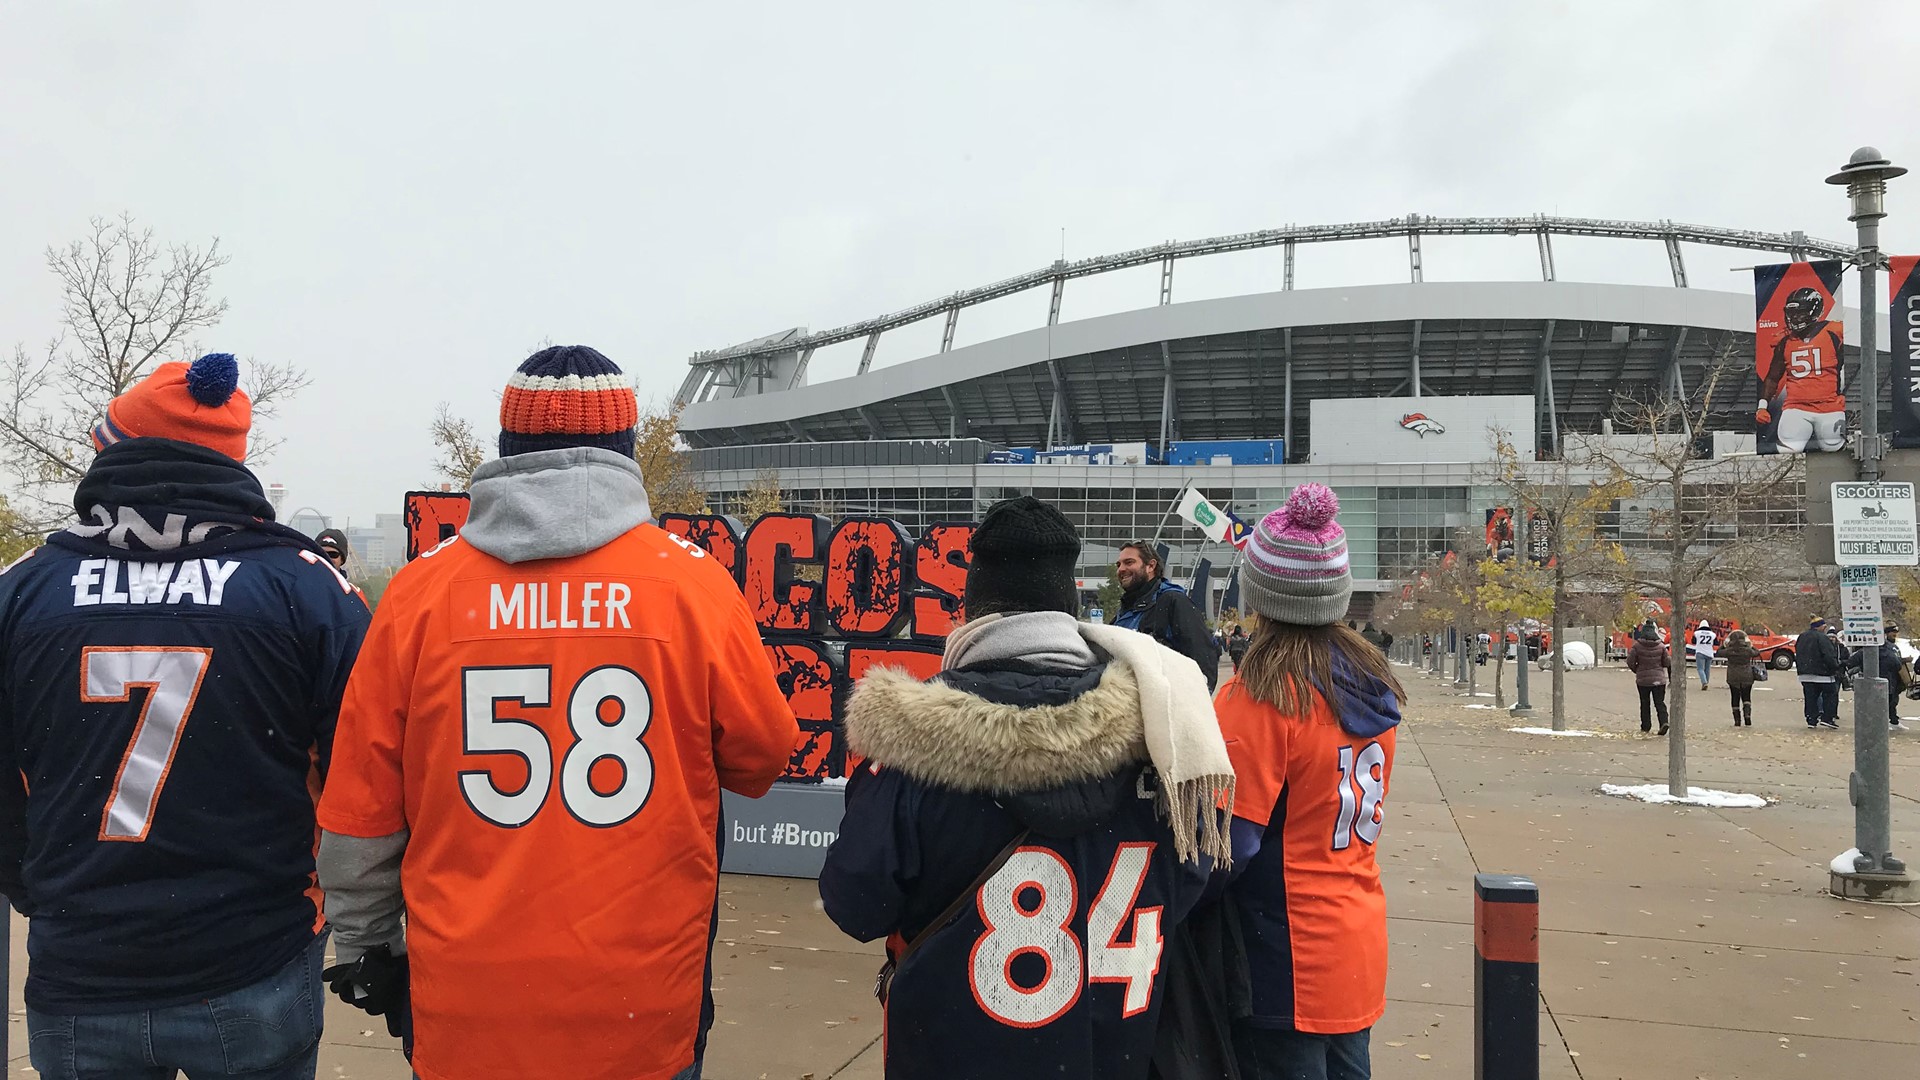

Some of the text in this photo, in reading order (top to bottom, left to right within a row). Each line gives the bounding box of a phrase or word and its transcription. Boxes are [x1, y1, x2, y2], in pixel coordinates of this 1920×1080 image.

[1790, 348, 1822, 379] 51
[1837, 487, 1910, 498] SCOOTERS
[1841, 543, 1913, 553] MUST BE WALKED
[71, 557, 242, 607] ELWAY
[1842, 568, 1877, 578] BE CLEAR
[489, 581, 633, 631] MILLER
[1699, 635, 1712, 645] 22
[79, 645, 214, 842] 7
[458, 664, 655, 828] 58
[1331, 740, 1386, 851] 18
[733, 819, 839, 848] but #Bron
[968, 841, 1165, 1030] 84
